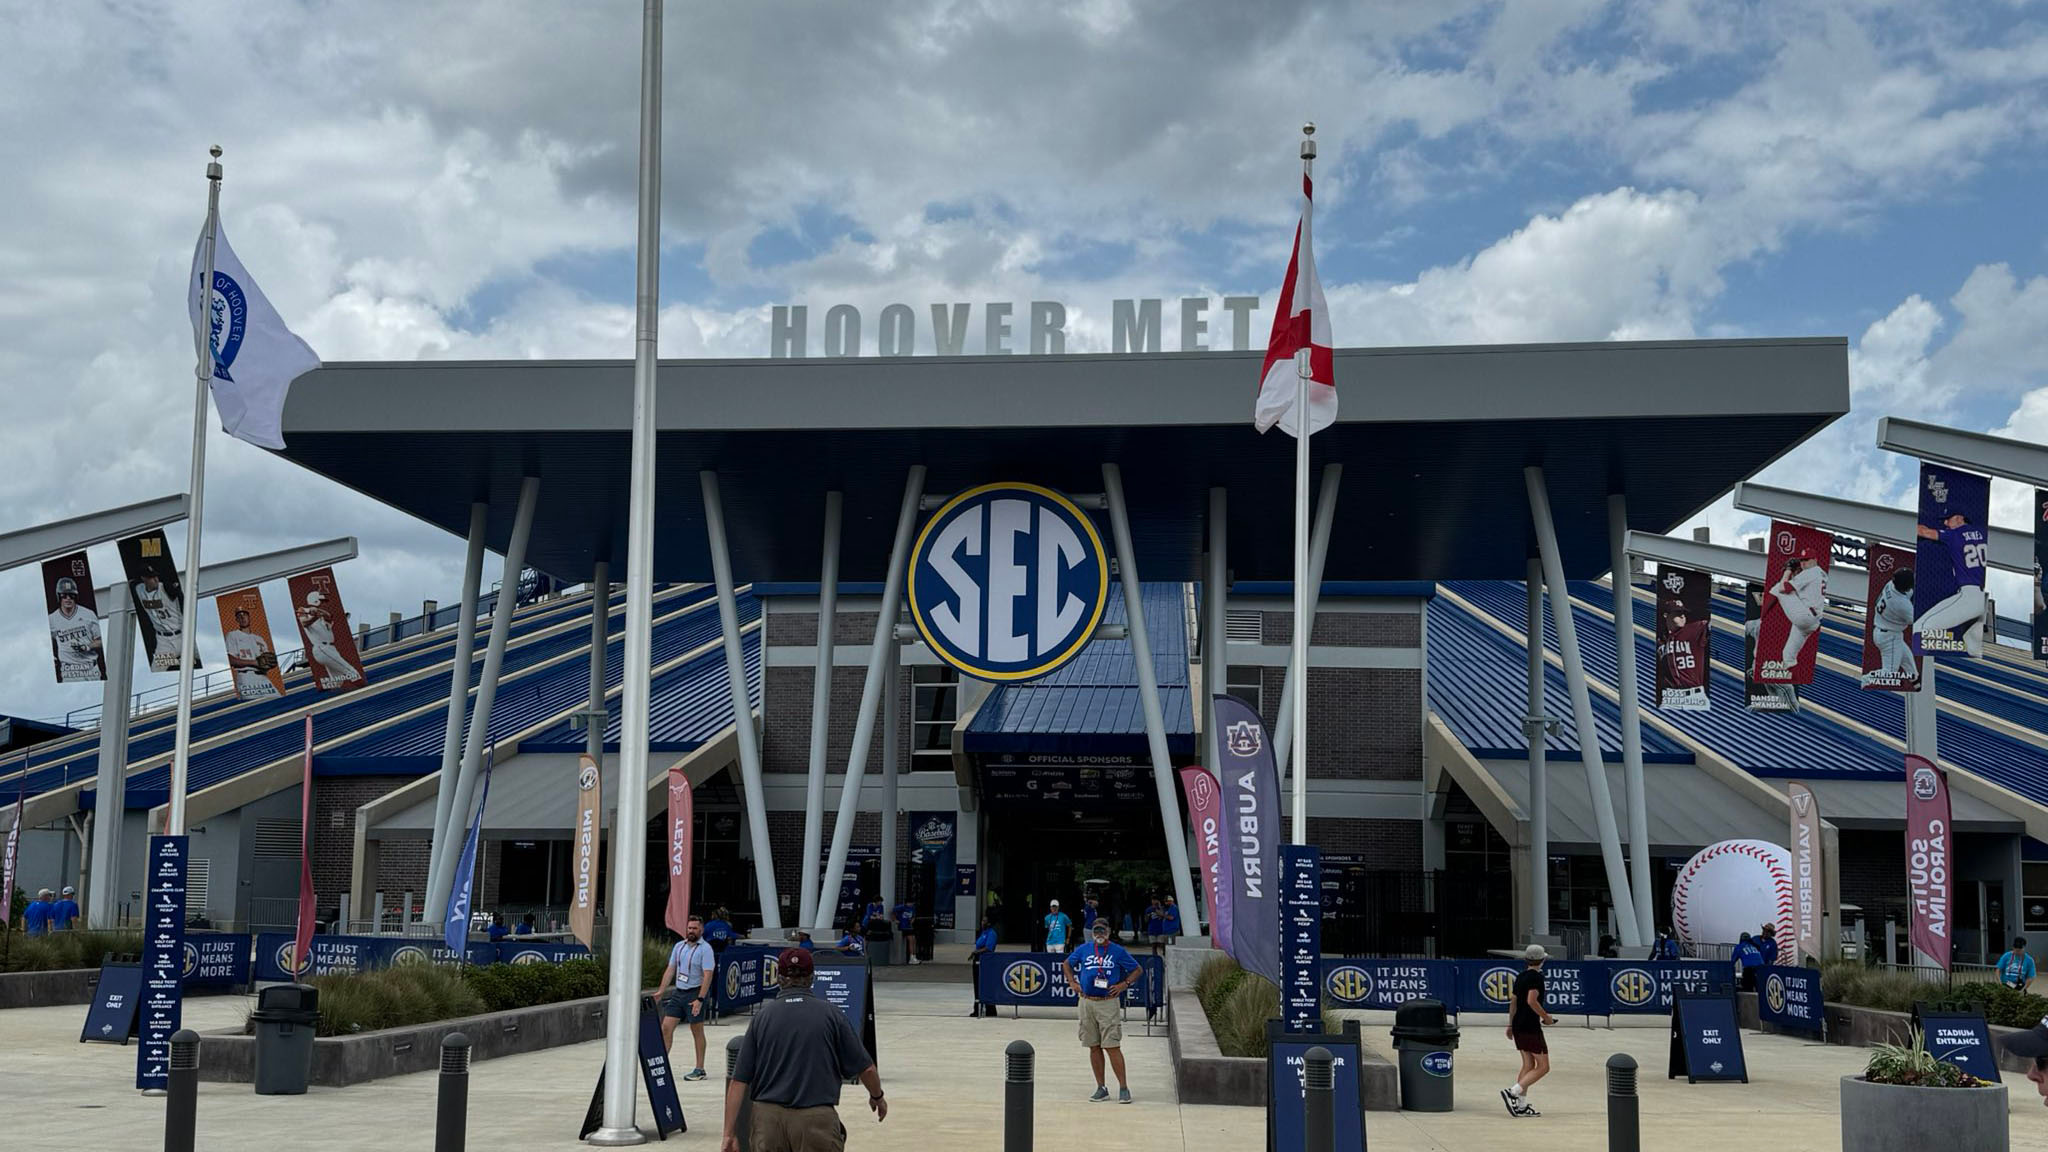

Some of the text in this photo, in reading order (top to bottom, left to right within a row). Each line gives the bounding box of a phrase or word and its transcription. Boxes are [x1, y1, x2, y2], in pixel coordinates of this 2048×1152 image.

[228, 290, 243, 341] HOOVER
[771, 296, 1260, 358] HOOVER MET
[1963, 543, 1988, 568] 20
[927, 498, 1087, 663] SEC
[1920, 630, 1949, 640] PAUL
[1920, 639, 1964, 651] SKENES
[60, 662, 92, 672] JORDAN
[1676, 655, 1696, 669] 36
[1762, 661, 1784, 669] JON
[320, 673, 359, 683] BRANDON
[1760, 669, 1788, 679] GRAY
[1869, 671, 1912, 679] CHRISTIAN
[1869, 678, 1901, 687] WALKER
[241, 688, 278, 697] CROCHET
[1662, 689, 1683, 697] ROSS
[1750, 694, 1779, 702] DANSBY
[1750, 701, 1788, 710] SWANSON
[1029, 755, 1132, 764] OFFICIAL SPONSORS
[202, 942, 235, 951] IT JUST
[317, 943, 358, 954] IT JUST
[201, 954, 233, 964] MEANS
[443, 949, 473, 959] JUT
[316, 954, 357, 966] MEANS
[746, 959, 757, 969] JUST
[741, 972, 756, 983] MEANS
[1377, 967, 1427, 978] IT JUST
[1660, 970, 1708, 980] IT JUST
[1009, 965, 1042, 993] SEC
[1785, 977, 1808, 989] IT JUST
[1332, 969, 1368, 1000] SEC
[1378, 979, 1428, 990] MEANS
[1543, 980, 1580, 991] EANS
[1616, 973, 1650, 1001] SEC
[1768, 977, 1785, 1010] SEC
[1786, 990, 1808, 1003] MEANS
[1546, 993, 1585, 1005] ORE.
[1703, 1029, 1719, 1037] EXIT
[1937, 1029, 1975, 1037] STADIUM
[1702, 1037, 1722, 1045] ONLY
[1936, 1037, 1981, 1045] ENTRANCE
